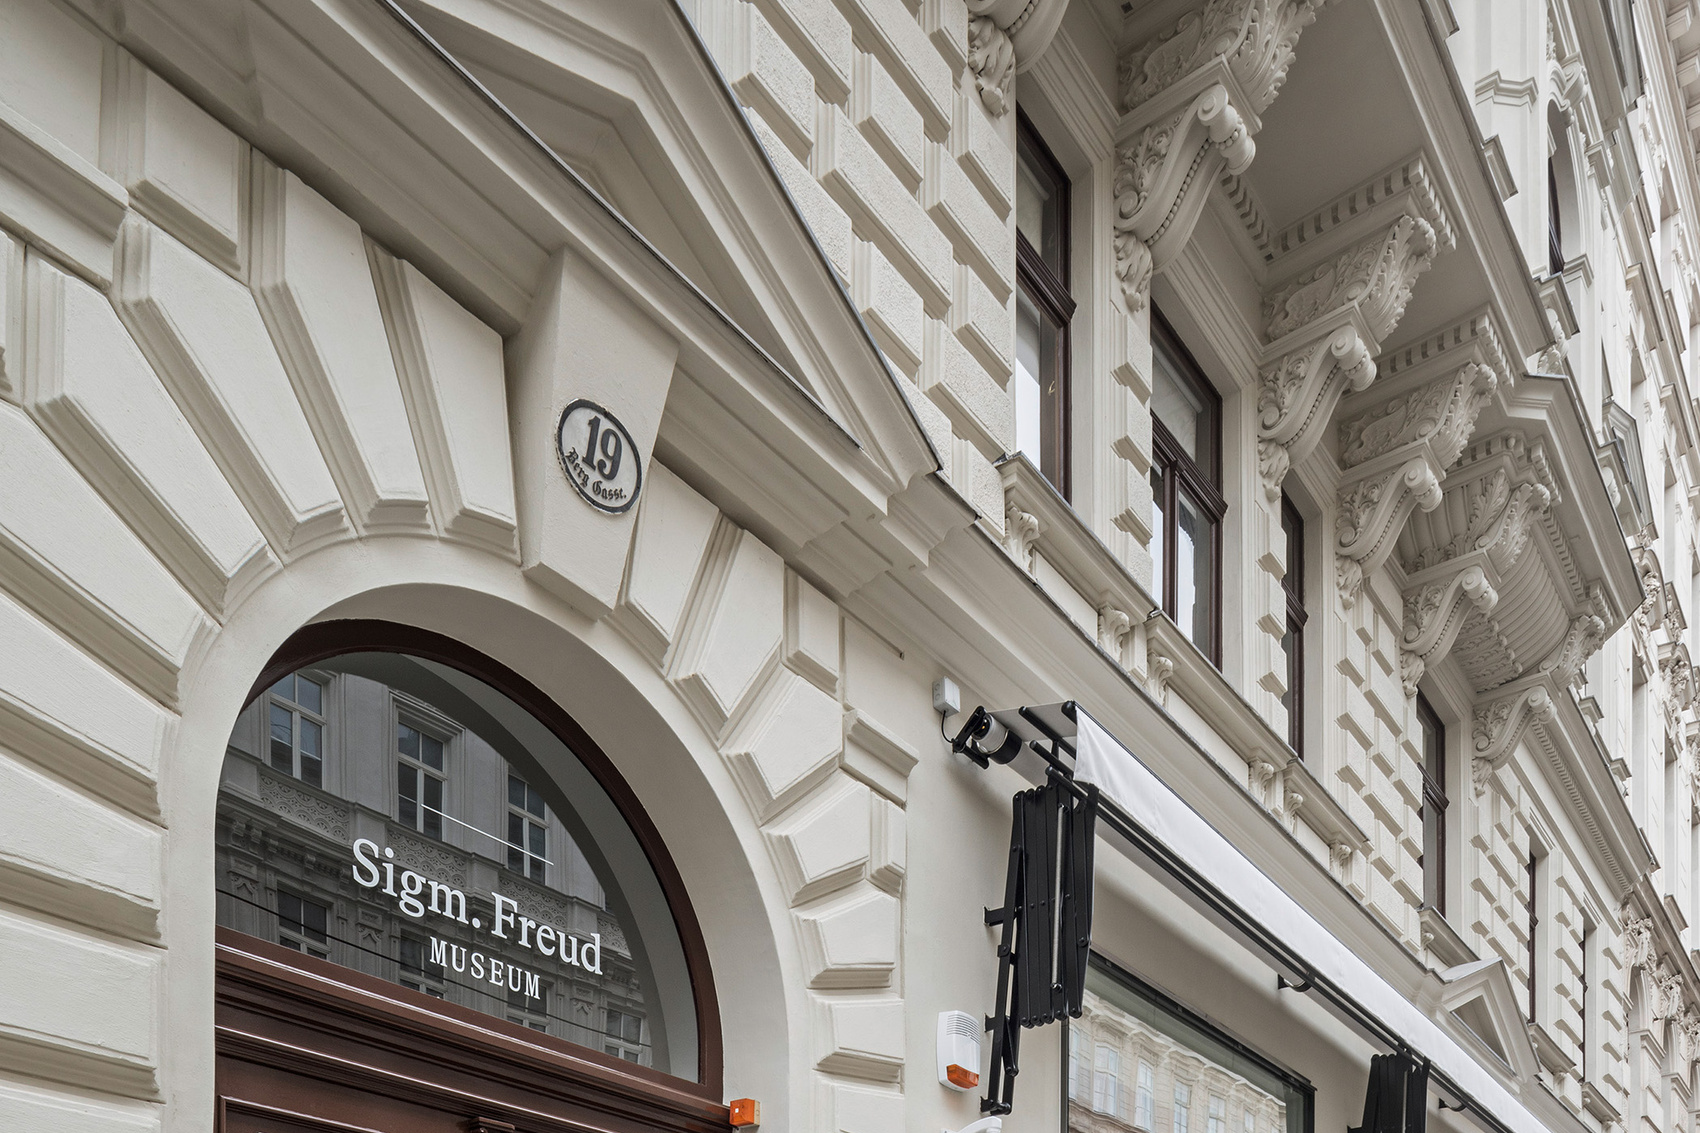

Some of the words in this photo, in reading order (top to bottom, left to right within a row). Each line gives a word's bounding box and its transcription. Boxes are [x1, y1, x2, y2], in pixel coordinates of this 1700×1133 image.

[565, 447, 589, 487] Berg
[582, 416, 622, 480] 19
[352, 838, 480, 928] Sigm.
[491, 892, 602, 975] Freud
[430, 936, 540, 999] MUSEUM
